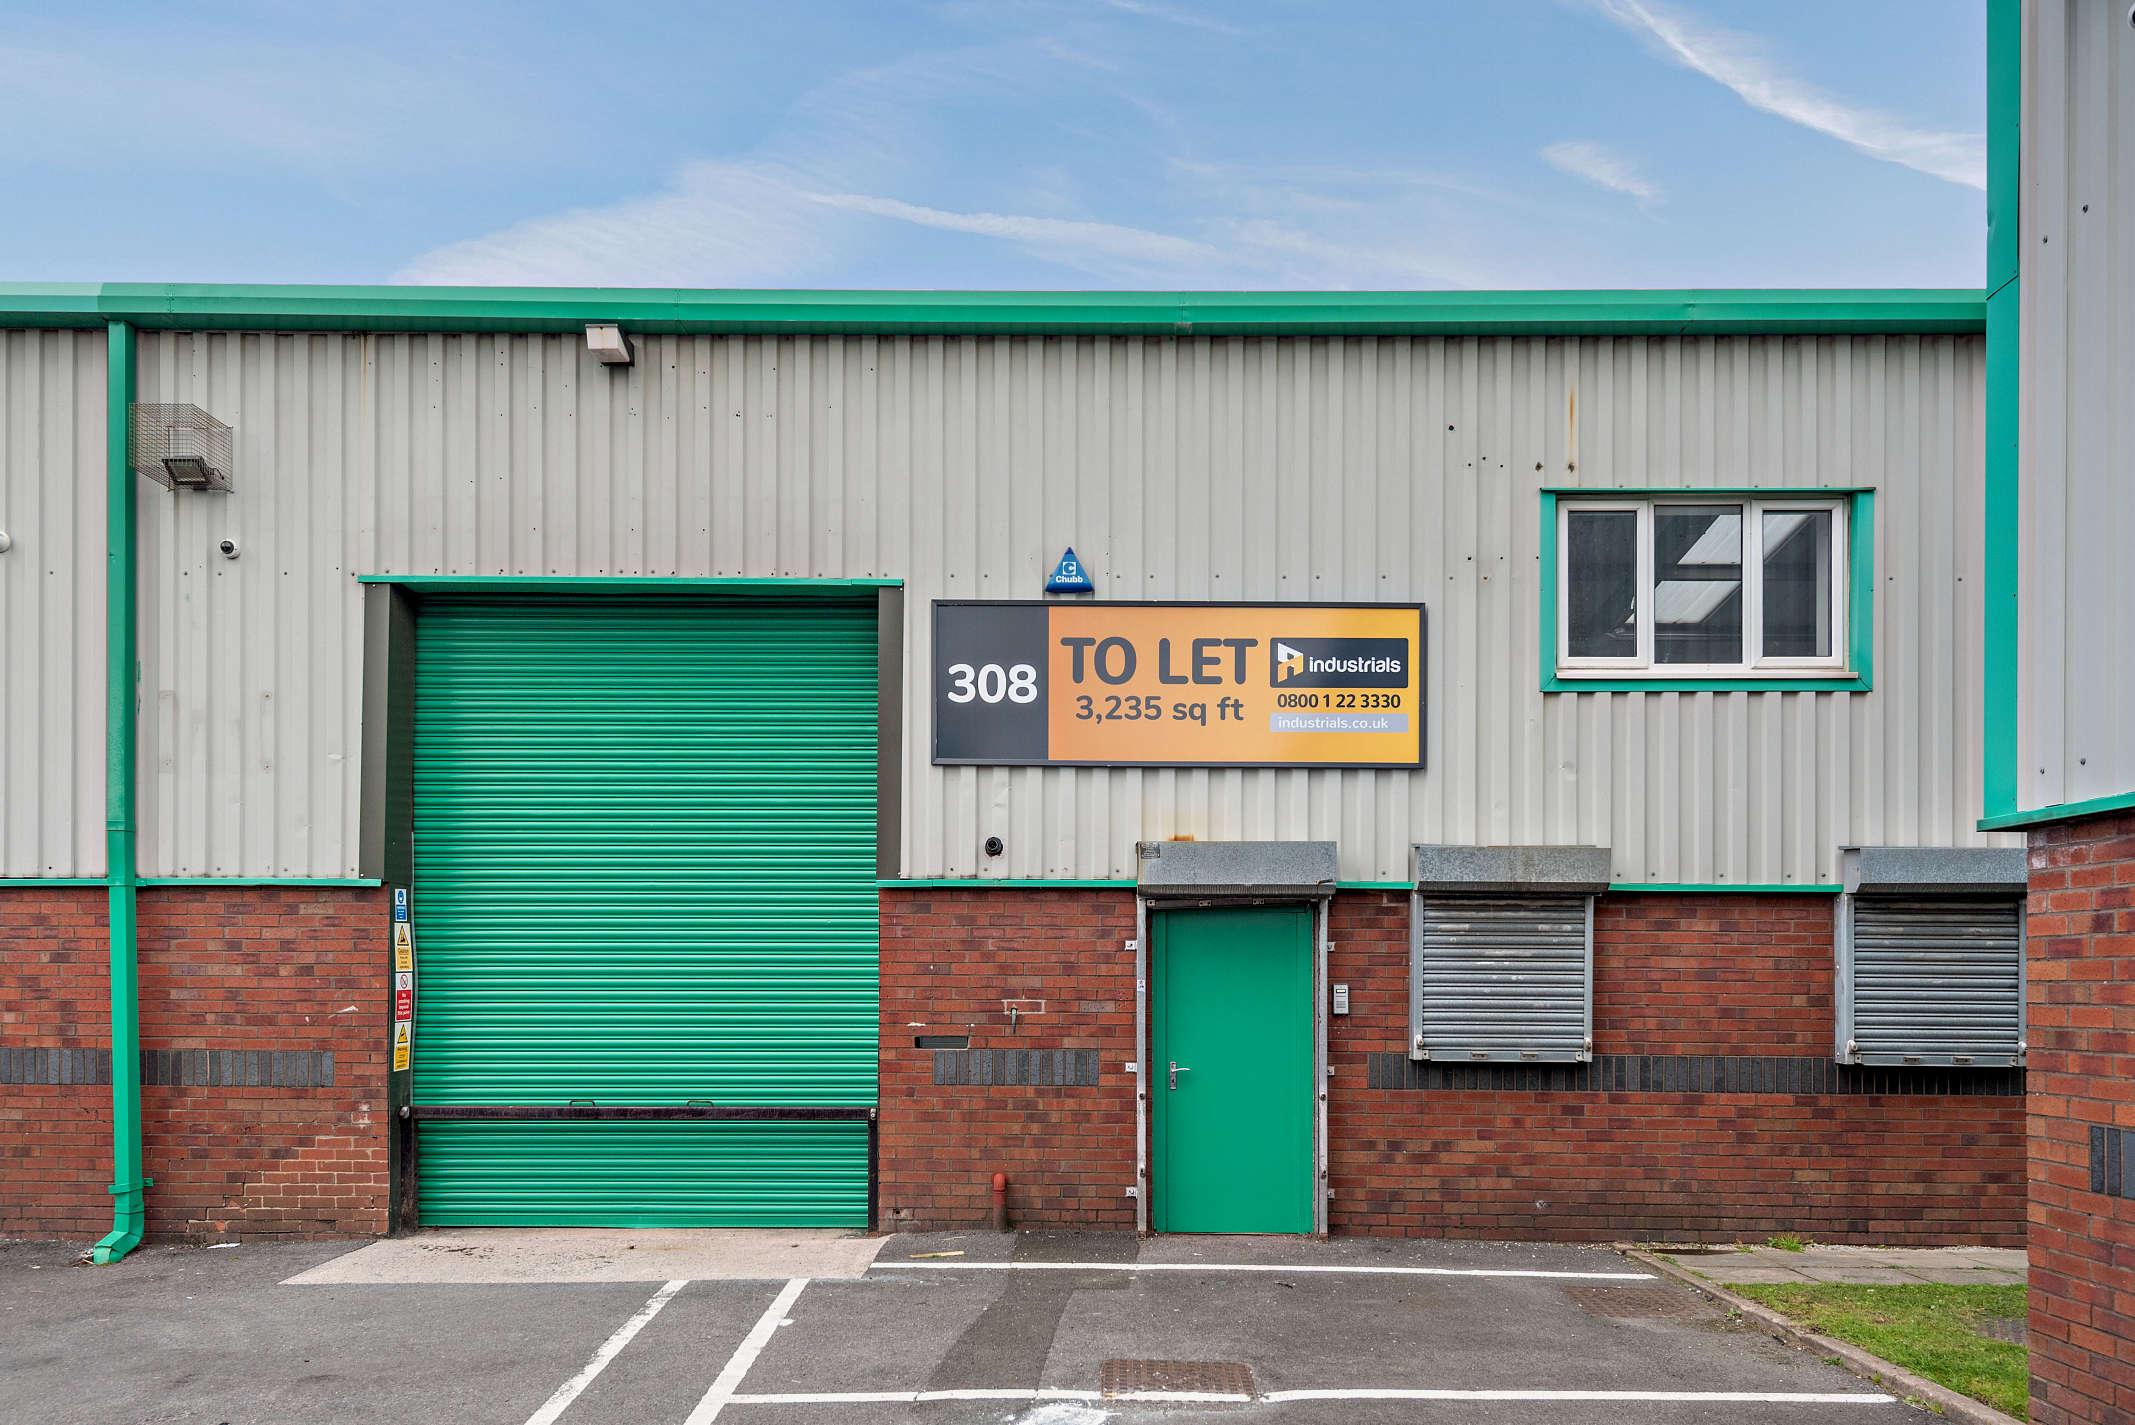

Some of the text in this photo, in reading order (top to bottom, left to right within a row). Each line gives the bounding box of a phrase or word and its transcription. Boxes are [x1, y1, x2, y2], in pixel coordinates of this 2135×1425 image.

[1055, 575, 1083, 583] Chubb
[1060, 636, 1259, 686] TO LET
[1309, 656, 1401, 673] industrials
[947, 663, 1038, 704] 308
[1277, 693, 1401, 708] 0800 1 22 3330
[1075, 695, 1244, 726] 3,235 sq ft
[1278, 716, 1388, 729] industrials.co.uk
